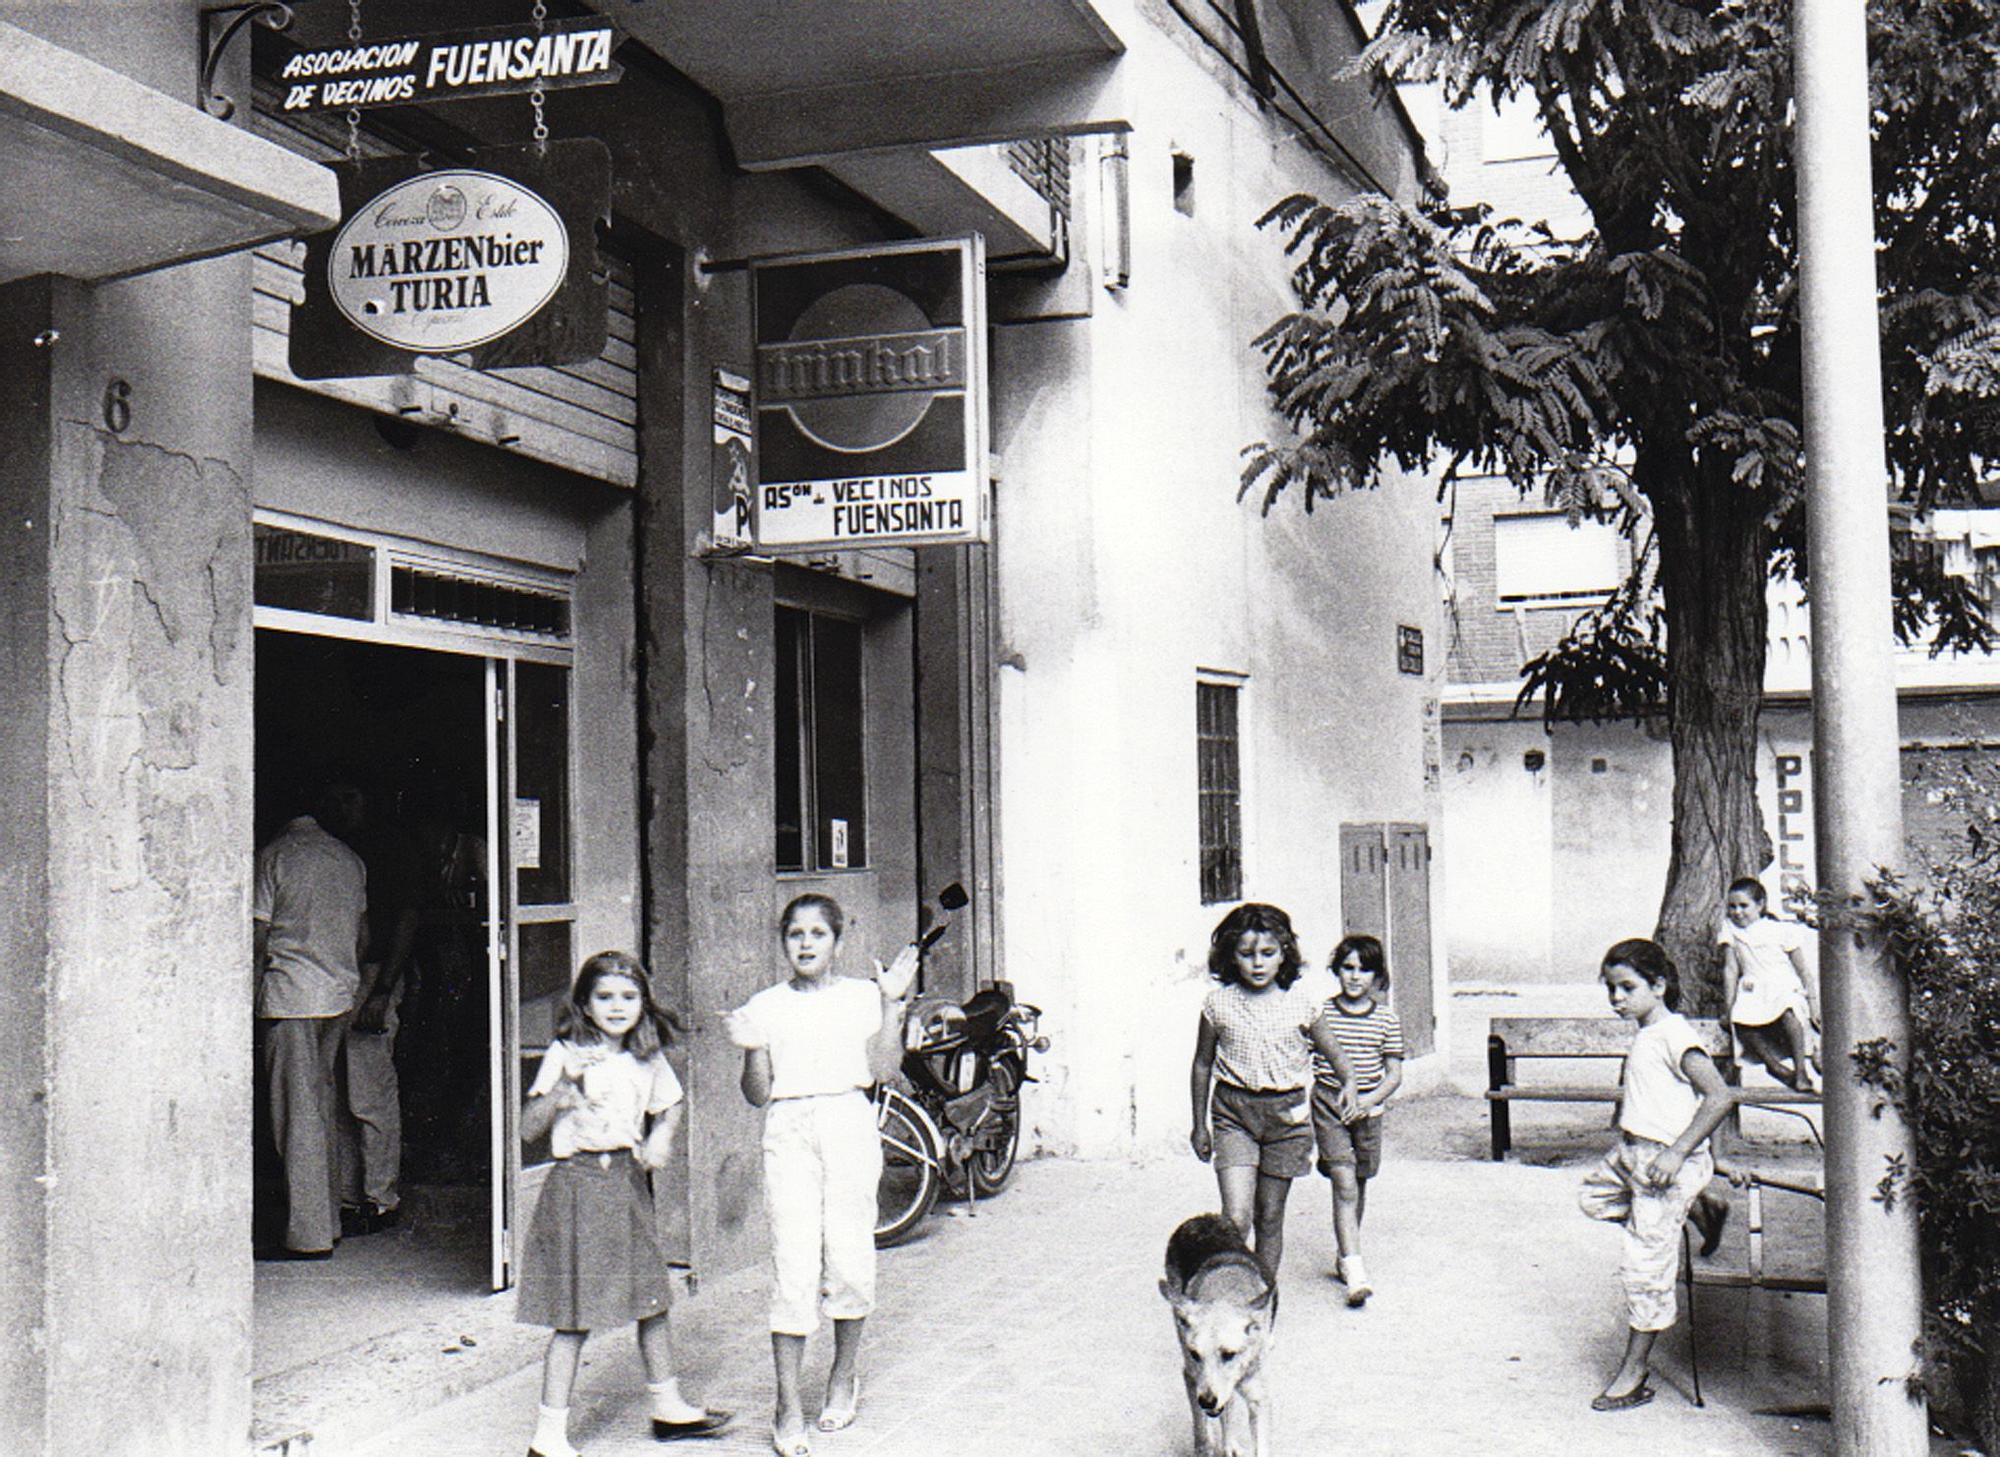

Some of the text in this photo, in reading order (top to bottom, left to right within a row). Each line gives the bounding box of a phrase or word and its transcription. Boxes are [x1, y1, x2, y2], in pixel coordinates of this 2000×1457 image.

[283, 41, 420, 79] ASOCIACION
[426, 29, 612, 89] FUENSANTA
[283, 75, 416, 110] DE VECINOS
[349, 233, 545, 280] MÄRZENbier
[389, 275, 492, 314] TURIA
[103, 379, 132, 434] 6
[833, 476, 932, 503] VECINOS
[833, 499, 963, 537] FUENSANTA
